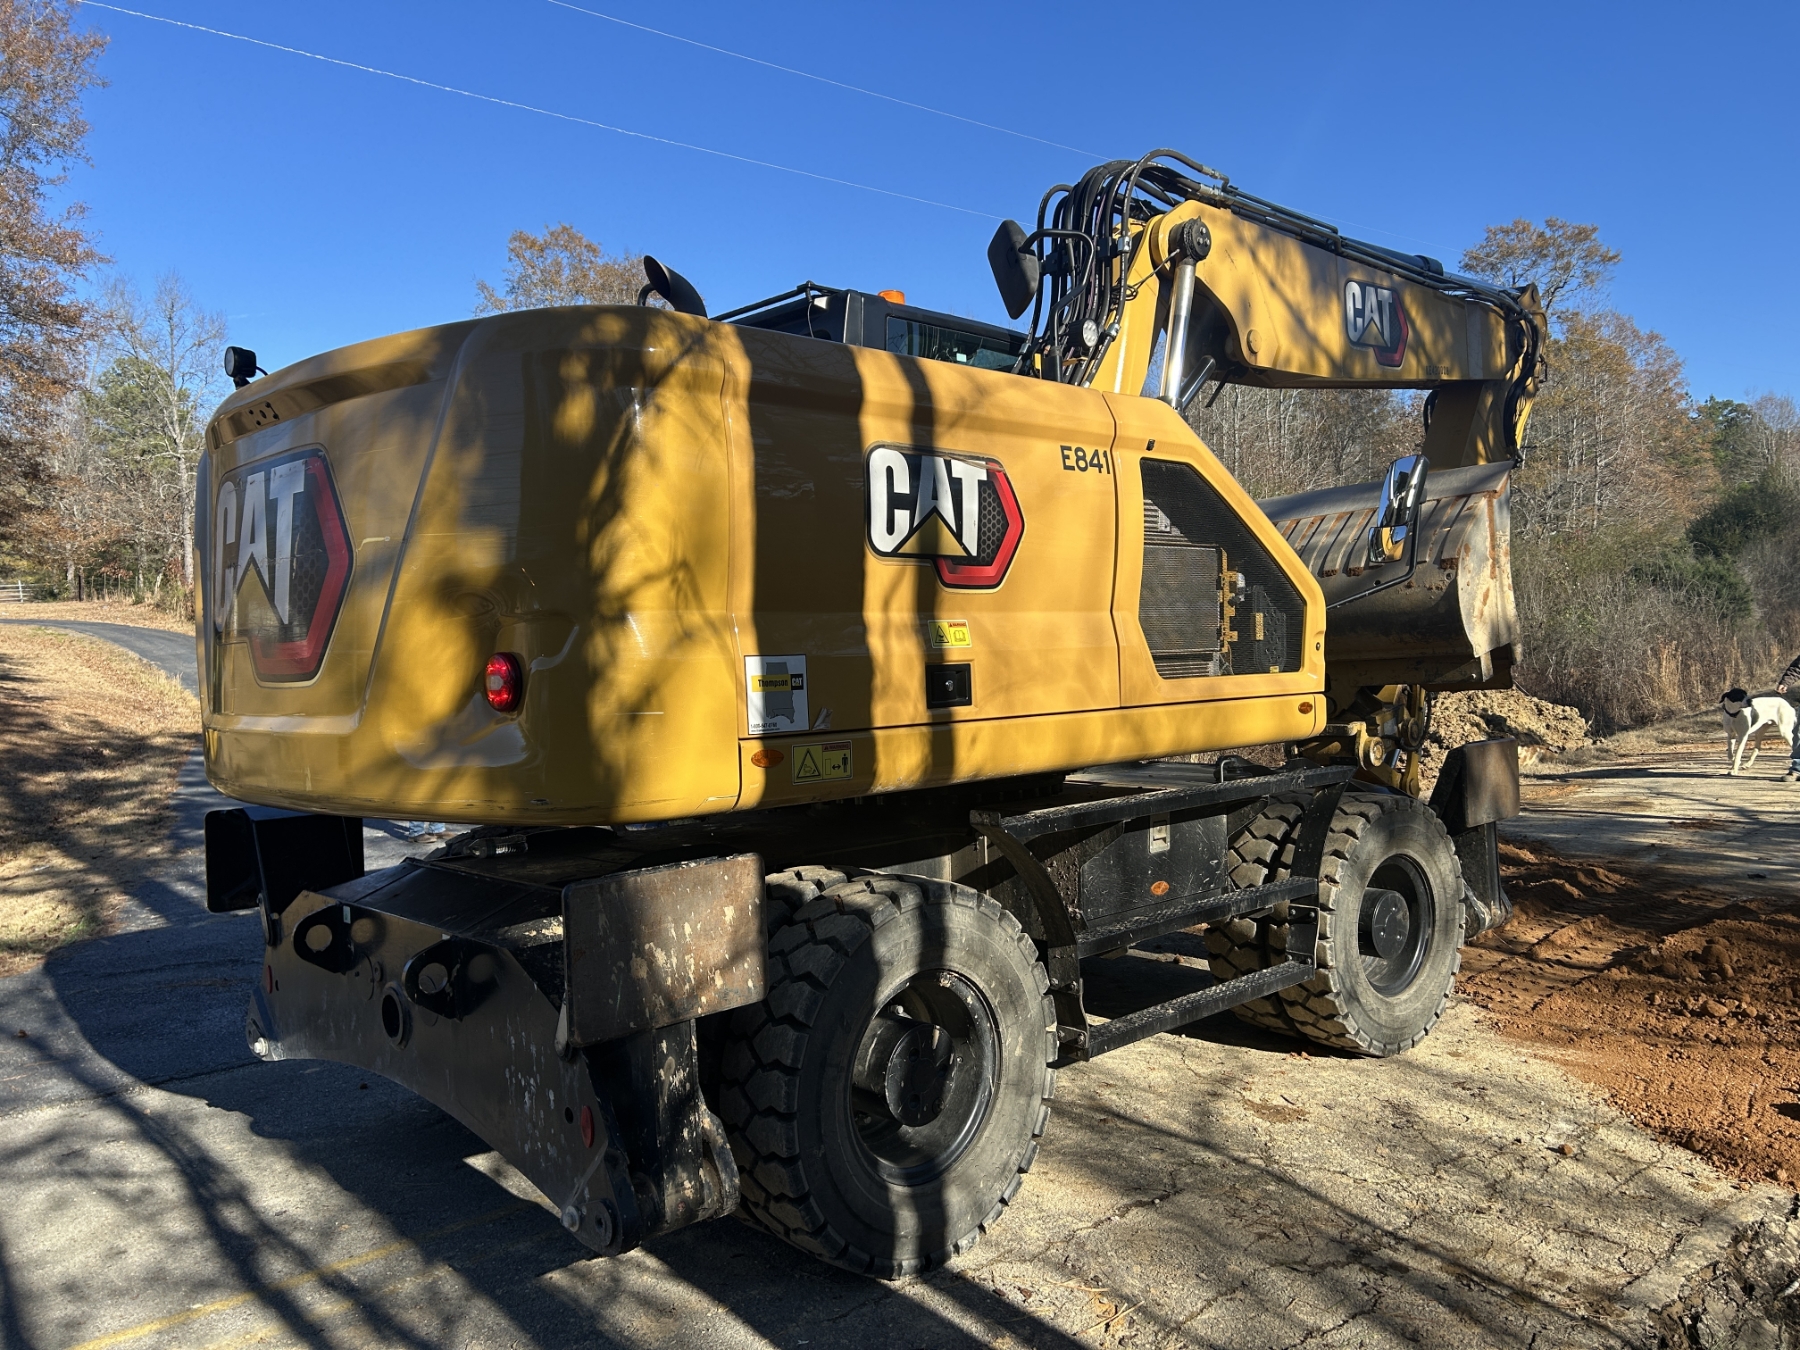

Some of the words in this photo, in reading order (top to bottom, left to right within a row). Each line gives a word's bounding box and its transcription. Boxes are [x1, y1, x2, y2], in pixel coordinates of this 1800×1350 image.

[1345, 281, 1393, 348] CAT
[1060, 444, 1111, 475] E841
[869, 447, 987, 557] CAT
[214, 459, 305, 633] CAT
[757, 678, 789, 688] Thompson
[791, 676, 803, 687] CAT
